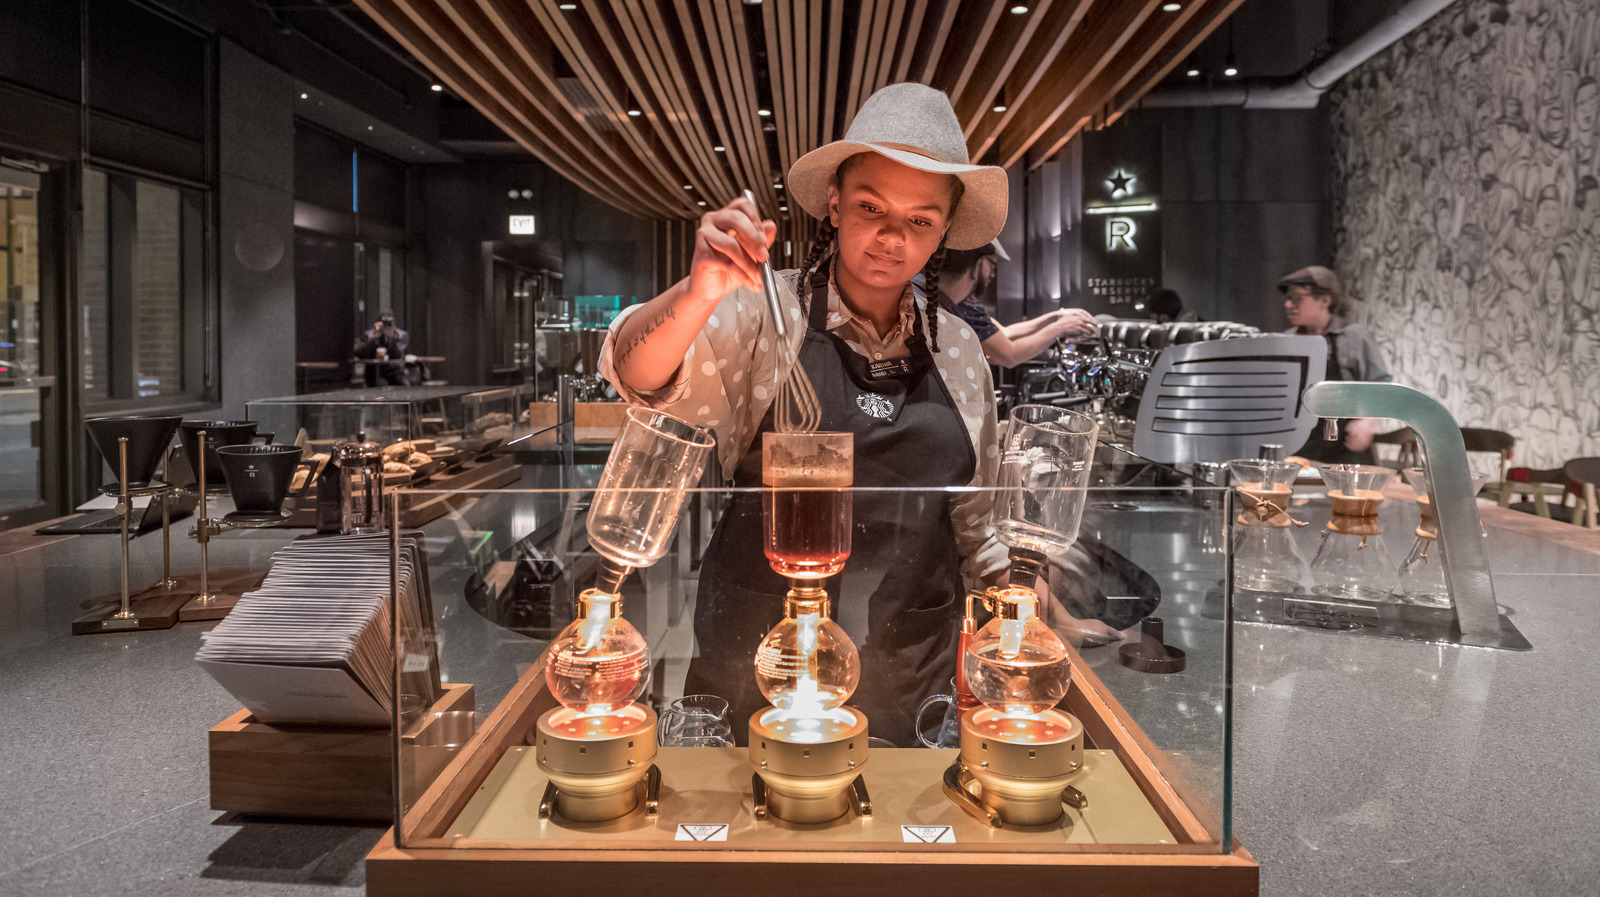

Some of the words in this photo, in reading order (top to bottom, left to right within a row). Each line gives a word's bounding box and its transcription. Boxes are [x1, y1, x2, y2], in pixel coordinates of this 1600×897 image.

[1106, 218, 1137, 251] R
[1087, 278, 1154, 287] STARBUCKS
[1093, 287, 1147, 296] RESERVE
[1109, 295, 1131, 304] BAR
